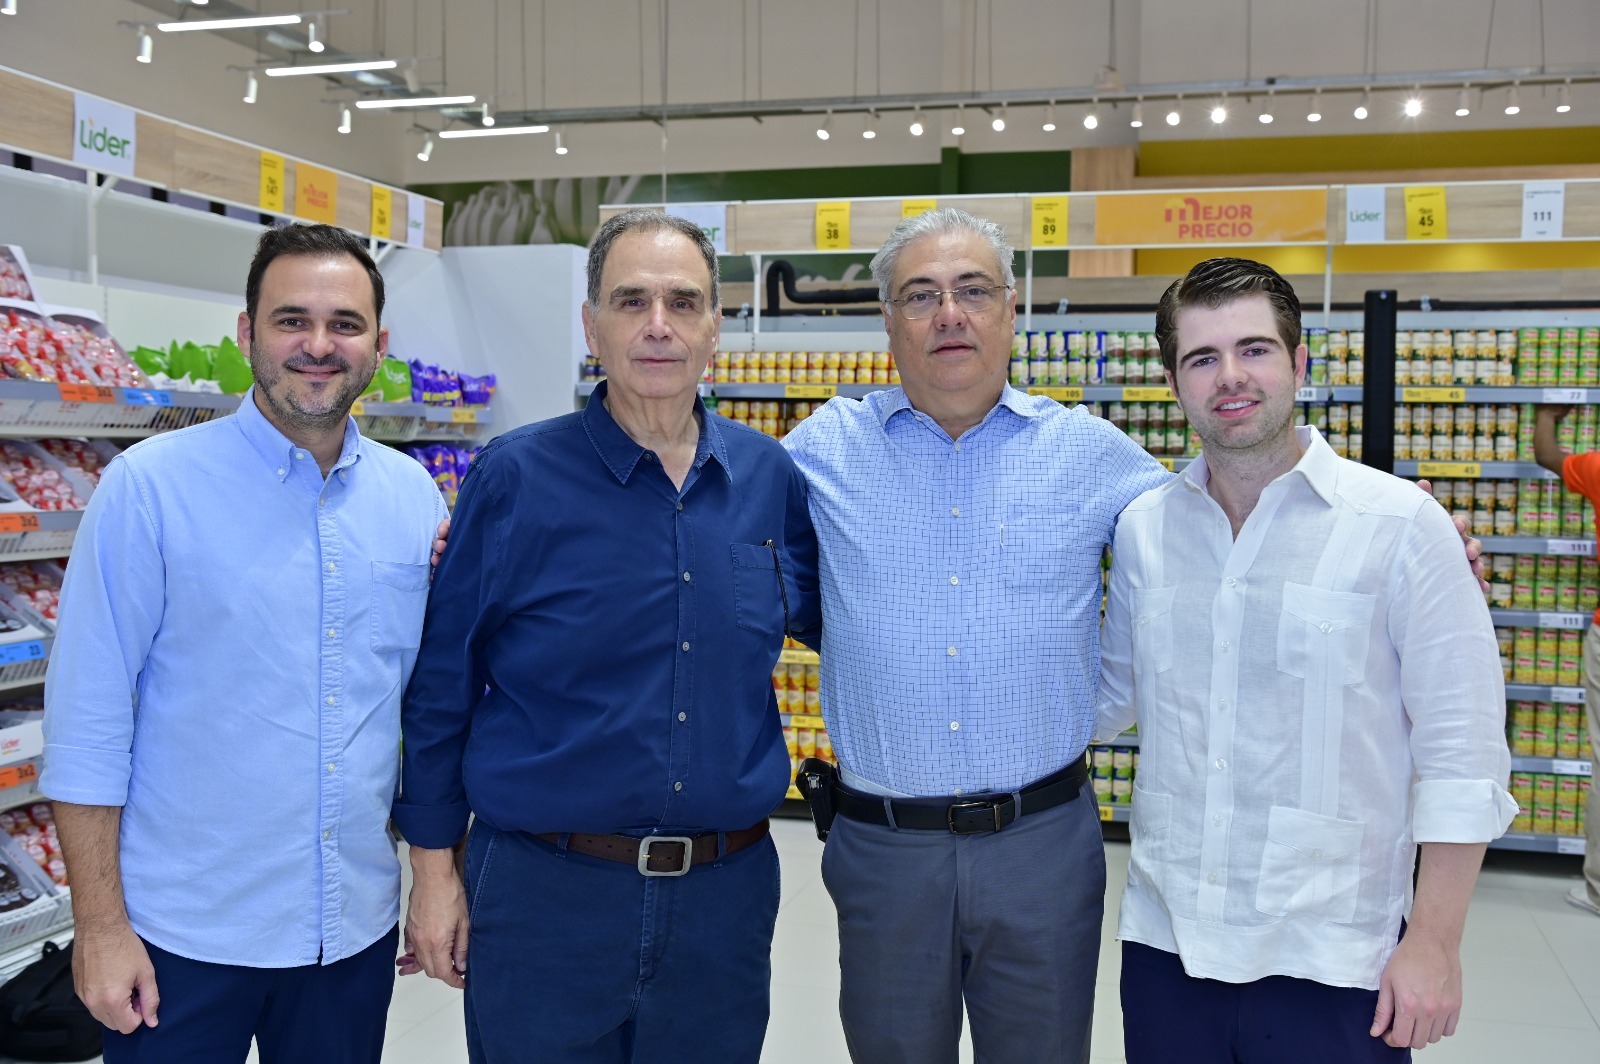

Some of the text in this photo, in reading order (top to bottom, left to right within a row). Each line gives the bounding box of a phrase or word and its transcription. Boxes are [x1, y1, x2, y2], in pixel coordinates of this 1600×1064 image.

[80, 116, 130, 158] Lider
[1165, 198, 1252, 222] MEJOR
[1418, 215, 1434, 227] 45
[1533, 211, 1552, 221] 111
[826, 229, 839, 240] 38
[1042, 224, 1056, 236] 89
[1178, 222, 1253, 239] PRECIO
[1065, 389, 1080, 398] 105
[1449, 390, 1460, 399] 45
[1570, 391, 1582, 400] 77
[1571, 543, 1588, 552] 111
[1563, 617, 1579, 626] 111
